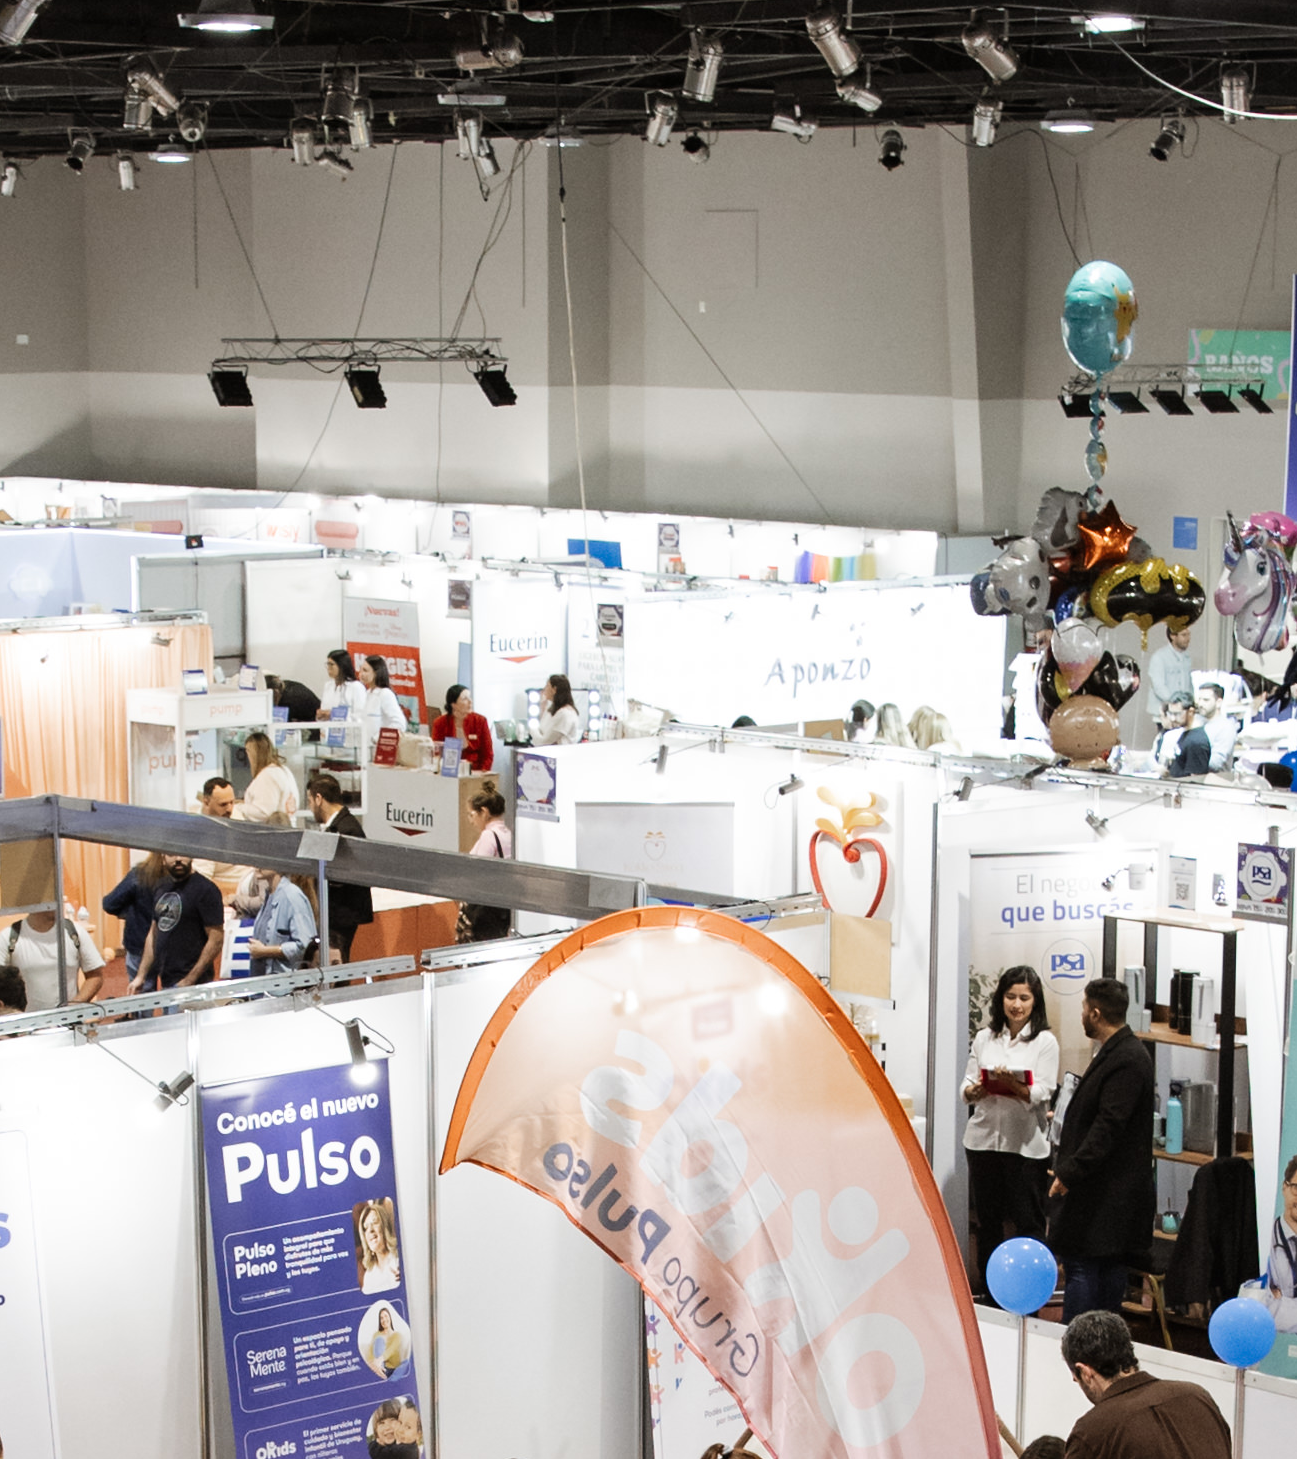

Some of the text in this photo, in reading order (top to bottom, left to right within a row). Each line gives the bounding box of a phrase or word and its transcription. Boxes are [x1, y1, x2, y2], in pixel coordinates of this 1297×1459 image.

[1205, 350, 1273, 374] BAÑOS
[490, 632, 548, 652] Eucerin
[354, 652, 417, 677] HGIES
[763, 657, 871, 698] Aponzo
[209, 703, 243, 717] pump
[386, 802, 434, 827] Eucerin
[1016, 873, 1034, 894] El
[1252, 865, 1272, 881] psa
[1001, 903, 1045, 928] que
[1051, 953, 1086, 972] psa
[217, 1093, 379, 1134] Conocé el nuevo
[222, 1127, 381, 1204] Pulso
[234, 1242, 276, 1262] Pulso
[235, 1260, 278, 1279] Pleno
[246, 1345, 288, 1366] Serena
[250, 1359, 287, 1379] Mente
